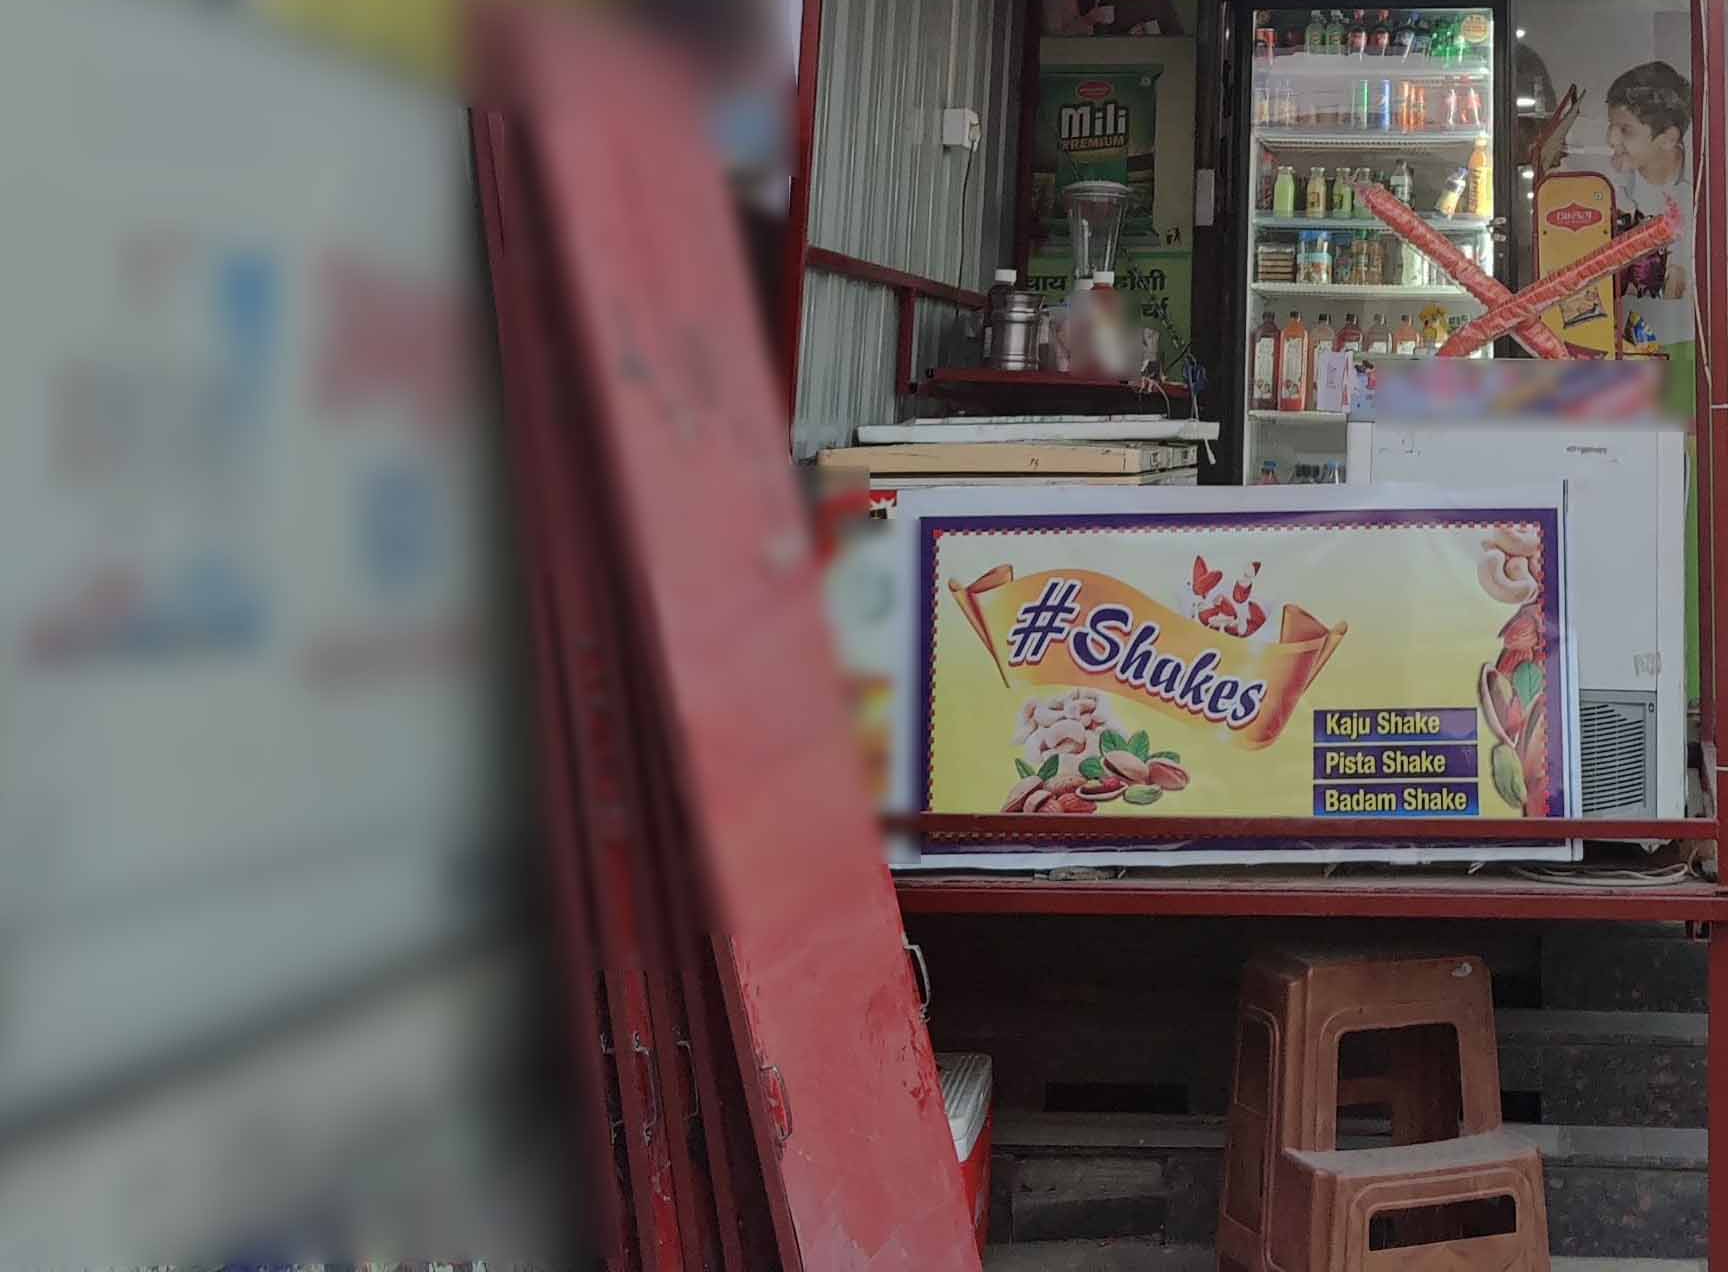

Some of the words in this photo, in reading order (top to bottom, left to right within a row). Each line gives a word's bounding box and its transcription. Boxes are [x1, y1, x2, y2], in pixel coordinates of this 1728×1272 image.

[1062, 135, 1127, 152] PREMIUM
[1009, 580, 1265, 726] #Shakes
[1326, 712, 1371, 739] Kaju
[1377, 712, 1440, 734] Shake
[1325, 751, 1376, 775] Pista
[1382, 750, 1446, 773] Shake
[1325, 789, 1397, 812] Badam
[1403, 788, 1468, 811] Shake
